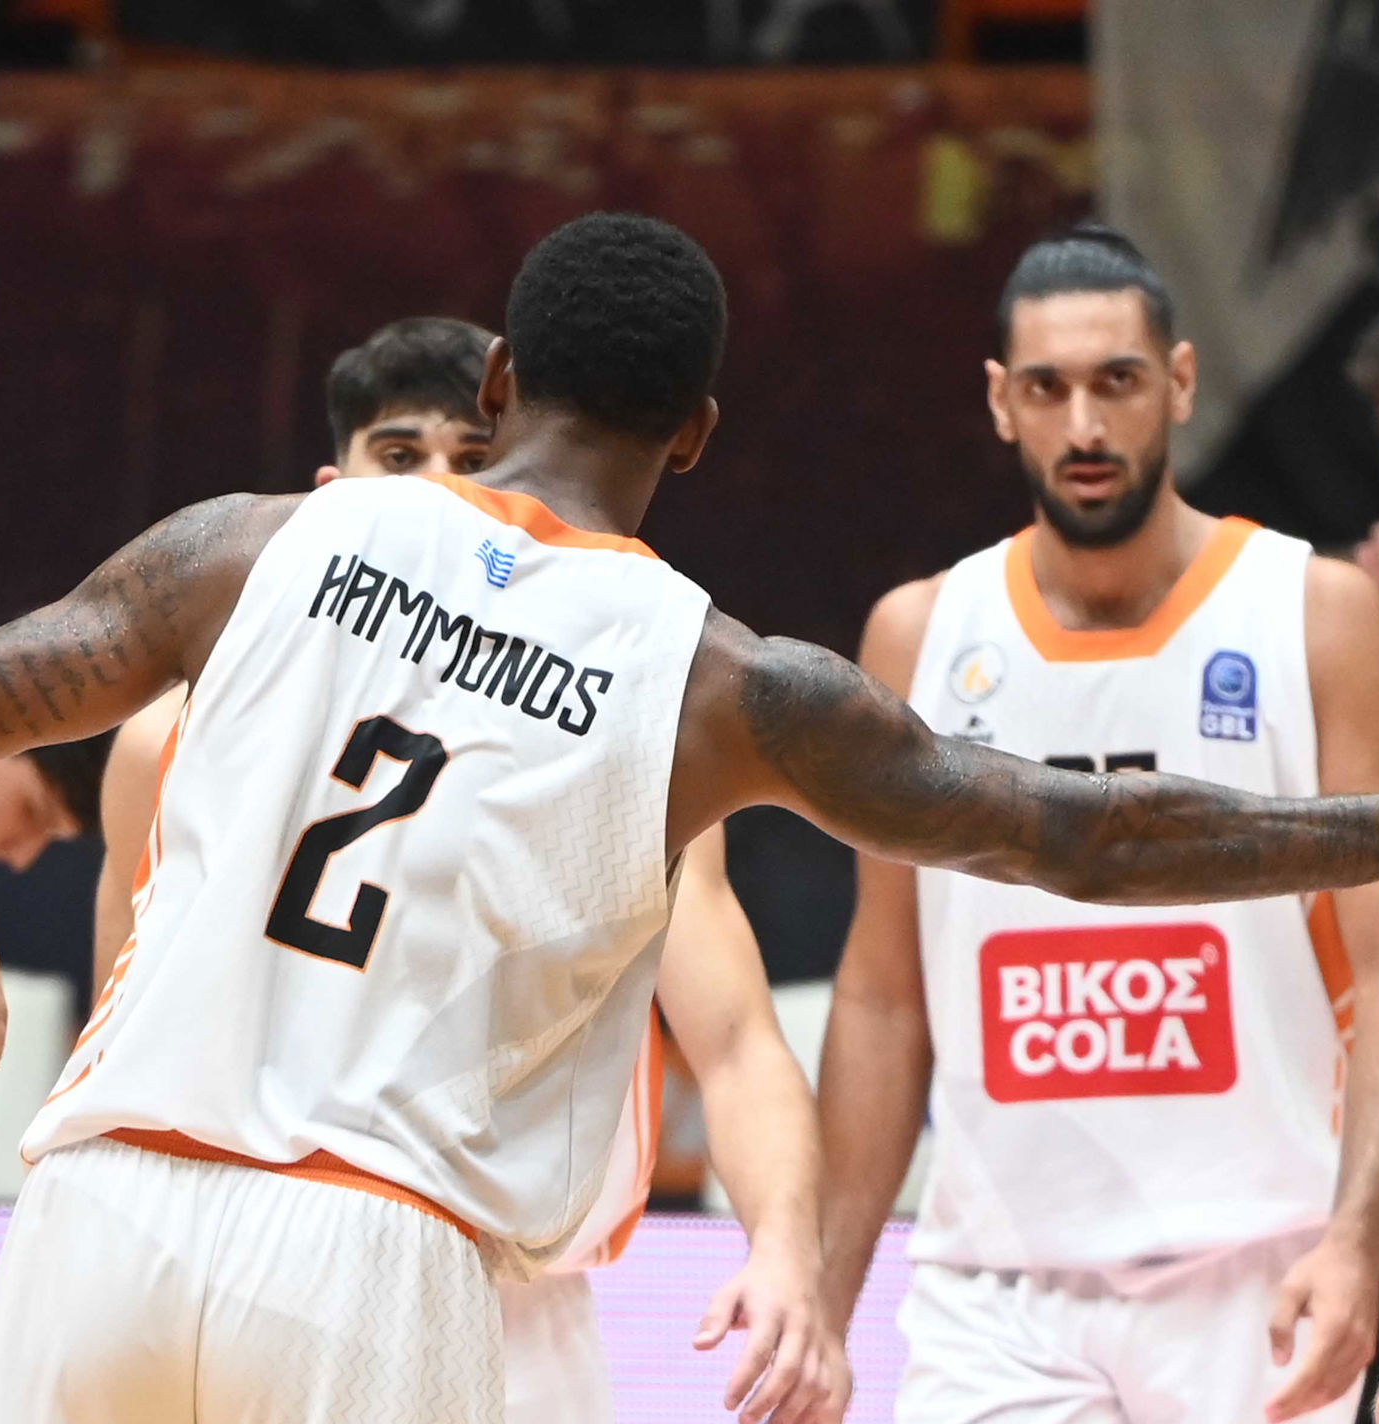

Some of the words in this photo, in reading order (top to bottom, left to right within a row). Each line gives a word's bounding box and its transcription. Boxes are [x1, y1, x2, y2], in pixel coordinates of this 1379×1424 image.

[308, 554, 614, 737] HAMMONDS
[264, 714, 450, 972] 2
[999, 958, 1207, 1021] ΒΙΚΟΣ
[1010, 1016, 1201, 1077] COLA
